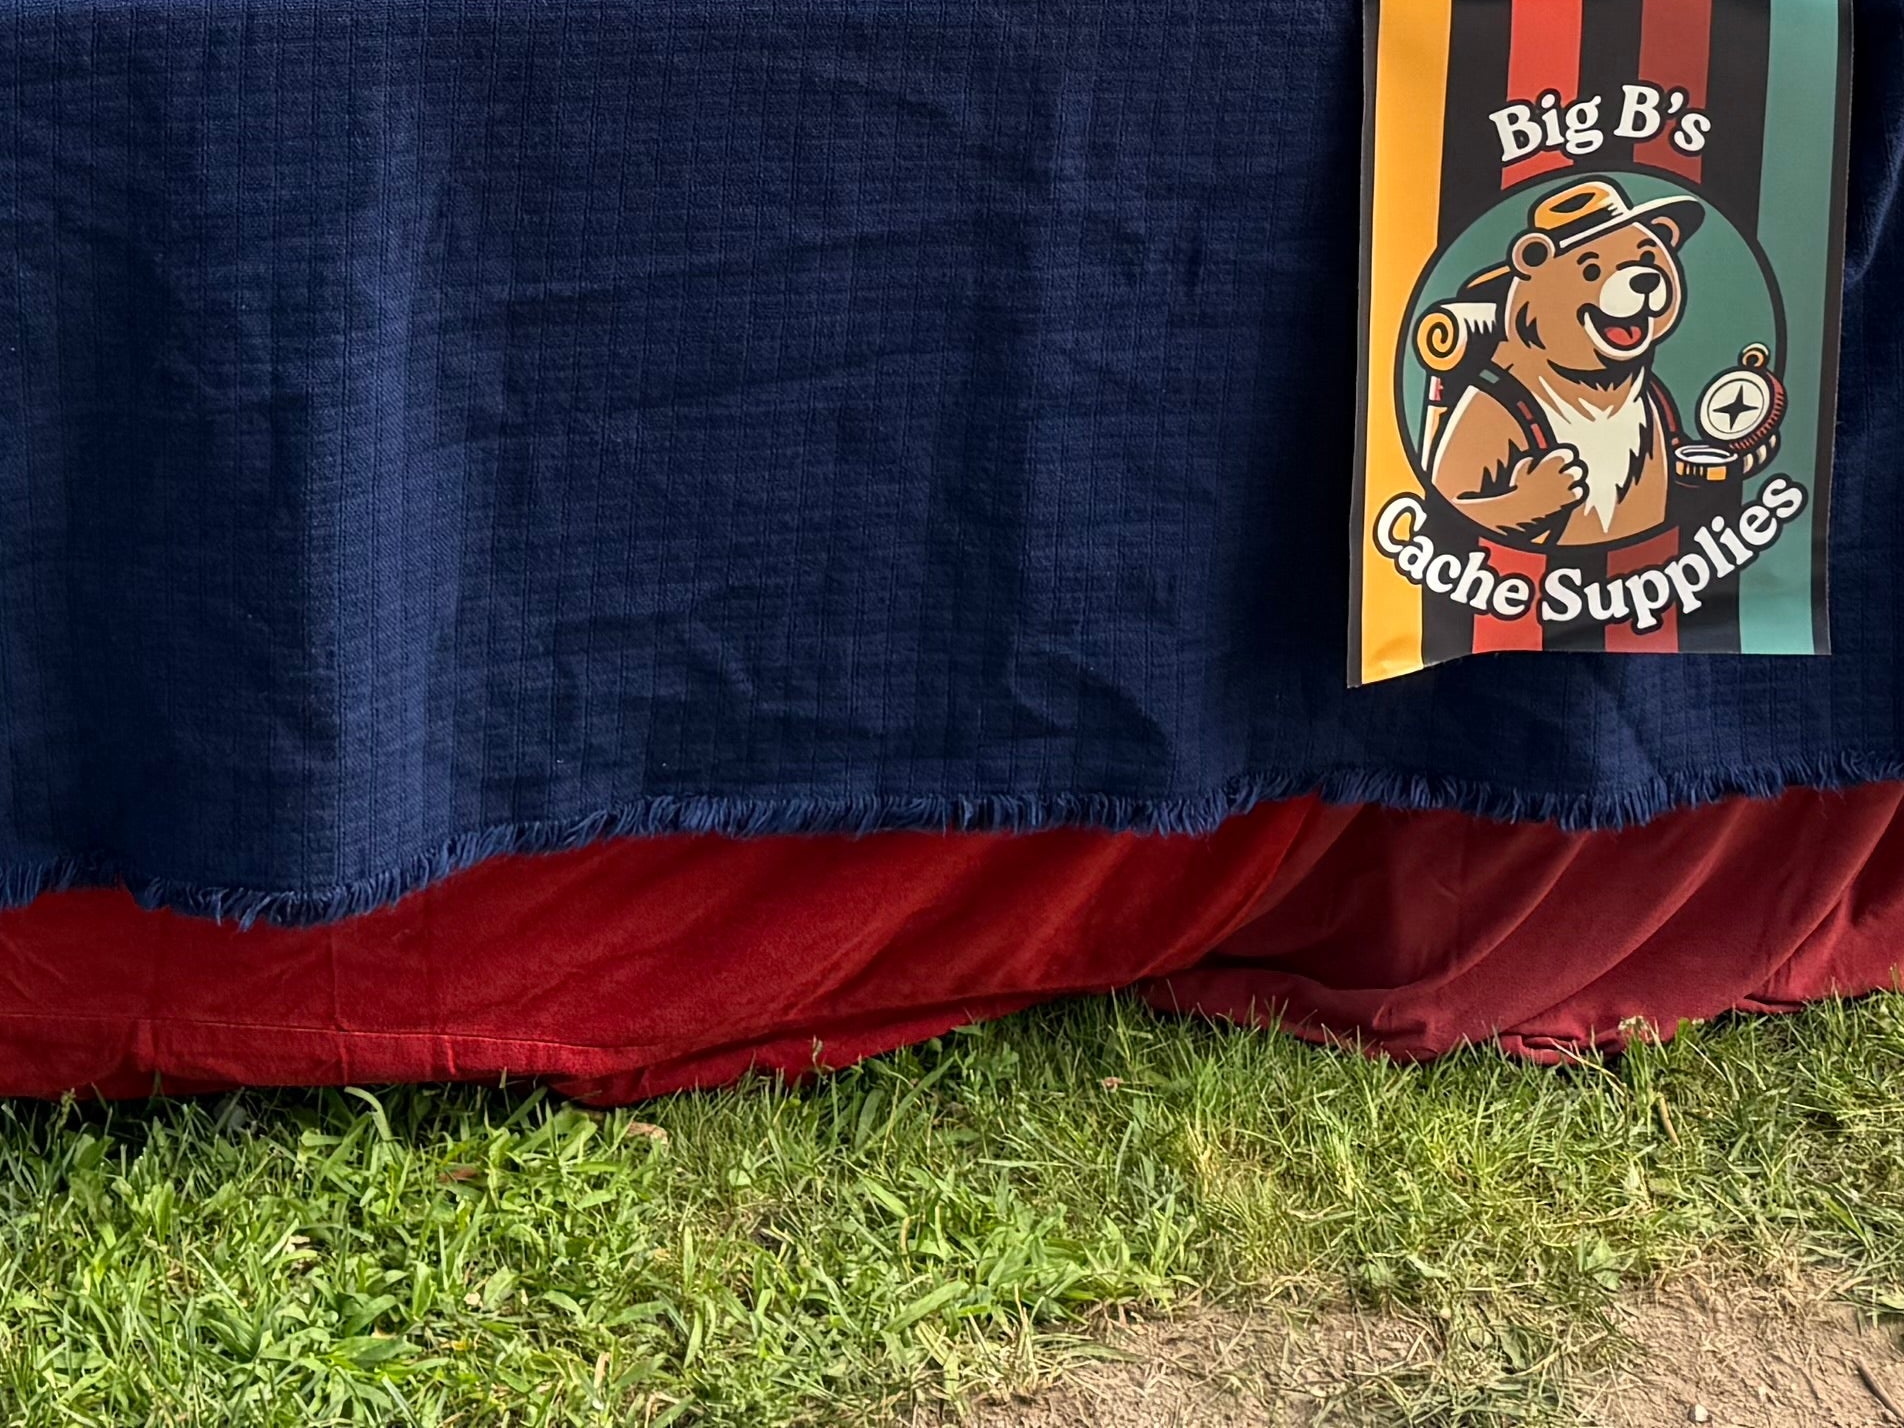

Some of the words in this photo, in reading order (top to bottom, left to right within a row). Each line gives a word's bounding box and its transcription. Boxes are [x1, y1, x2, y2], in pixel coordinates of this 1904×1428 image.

[1489, 93, 1604, 163] Big
[1613, 83, 1712, 153] B's
[1374, 495, 1530, 615] Cache
[1540, 473, 1806, 629] Supplies
